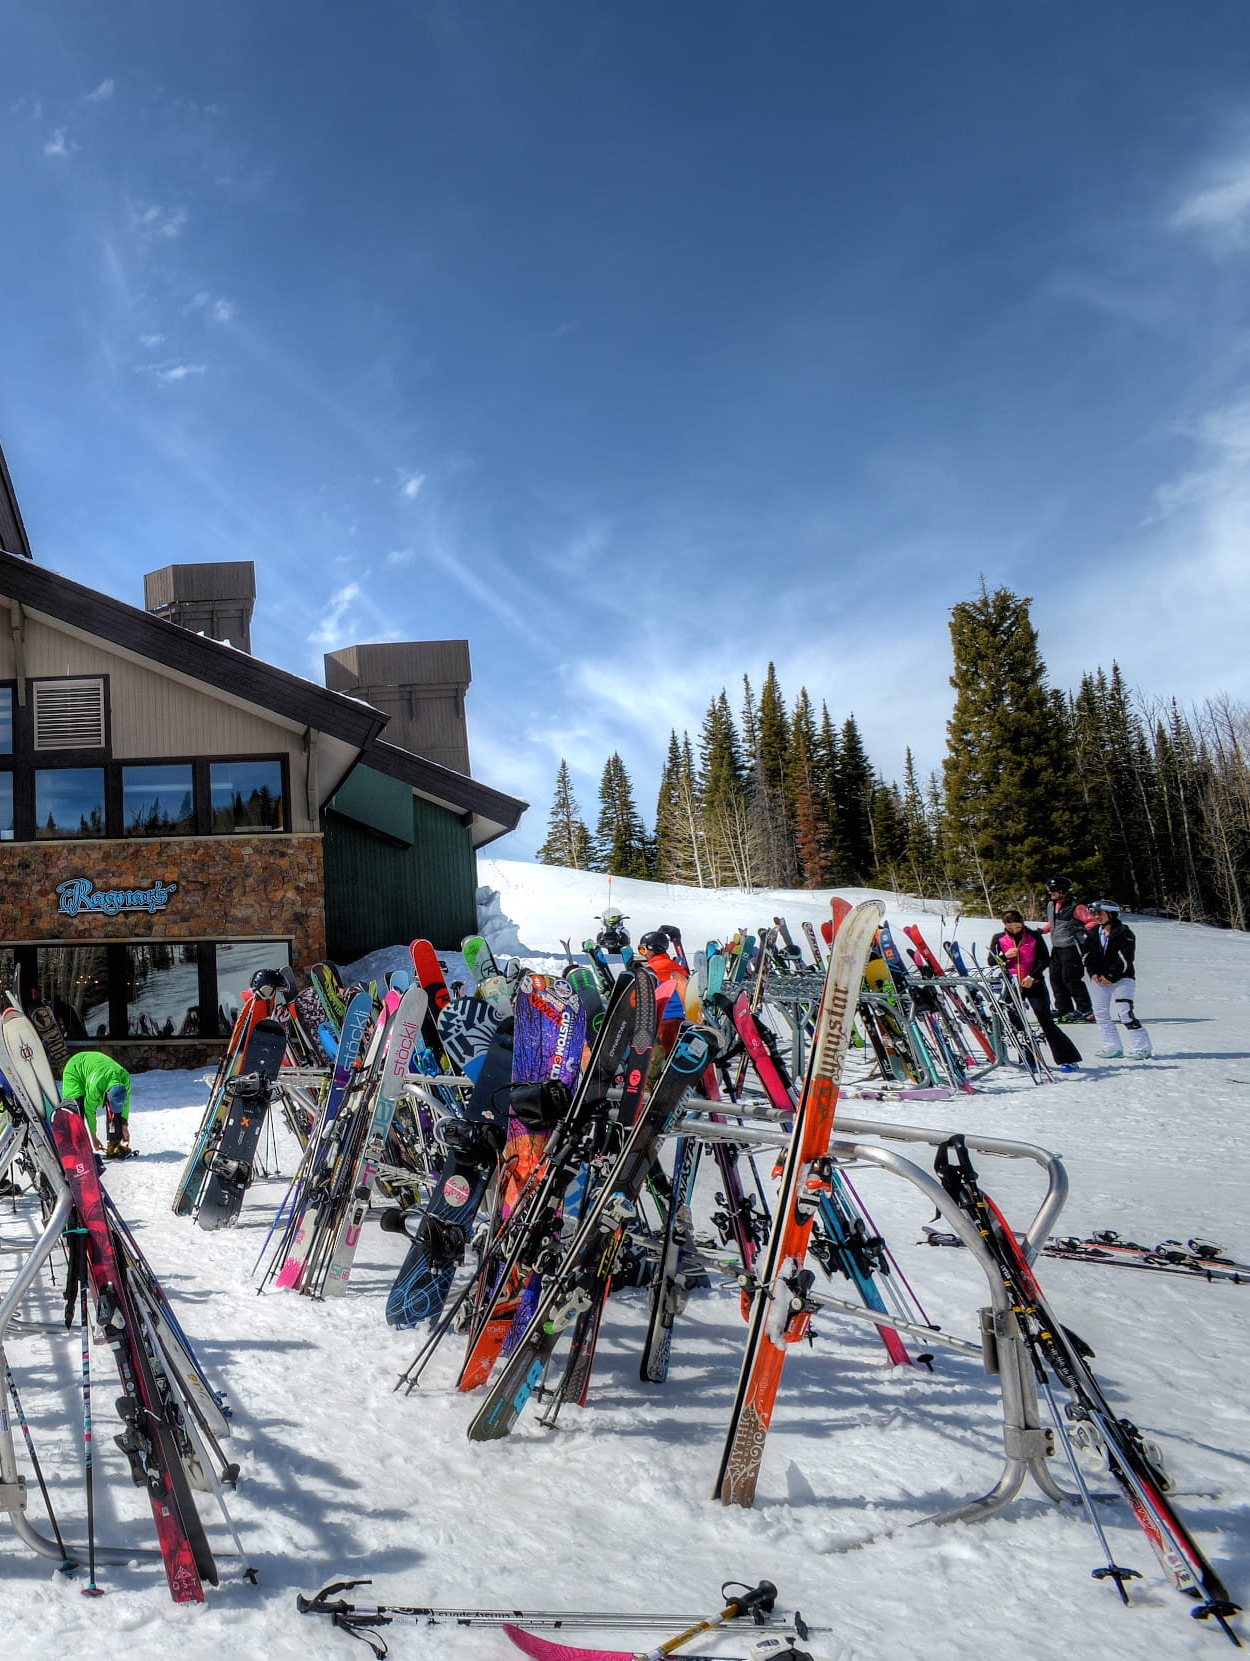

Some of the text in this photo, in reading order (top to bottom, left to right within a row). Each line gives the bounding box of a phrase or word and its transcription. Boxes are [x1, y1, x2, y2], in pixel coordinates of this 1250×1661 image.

[56, 878, 177, 916] Ragnar's
[393, 1022, 417, 1078] stöckli
[609, 1020, 627, 1057] DYNASTAR
[729, 1413, 749, 1478] MYTHIC
